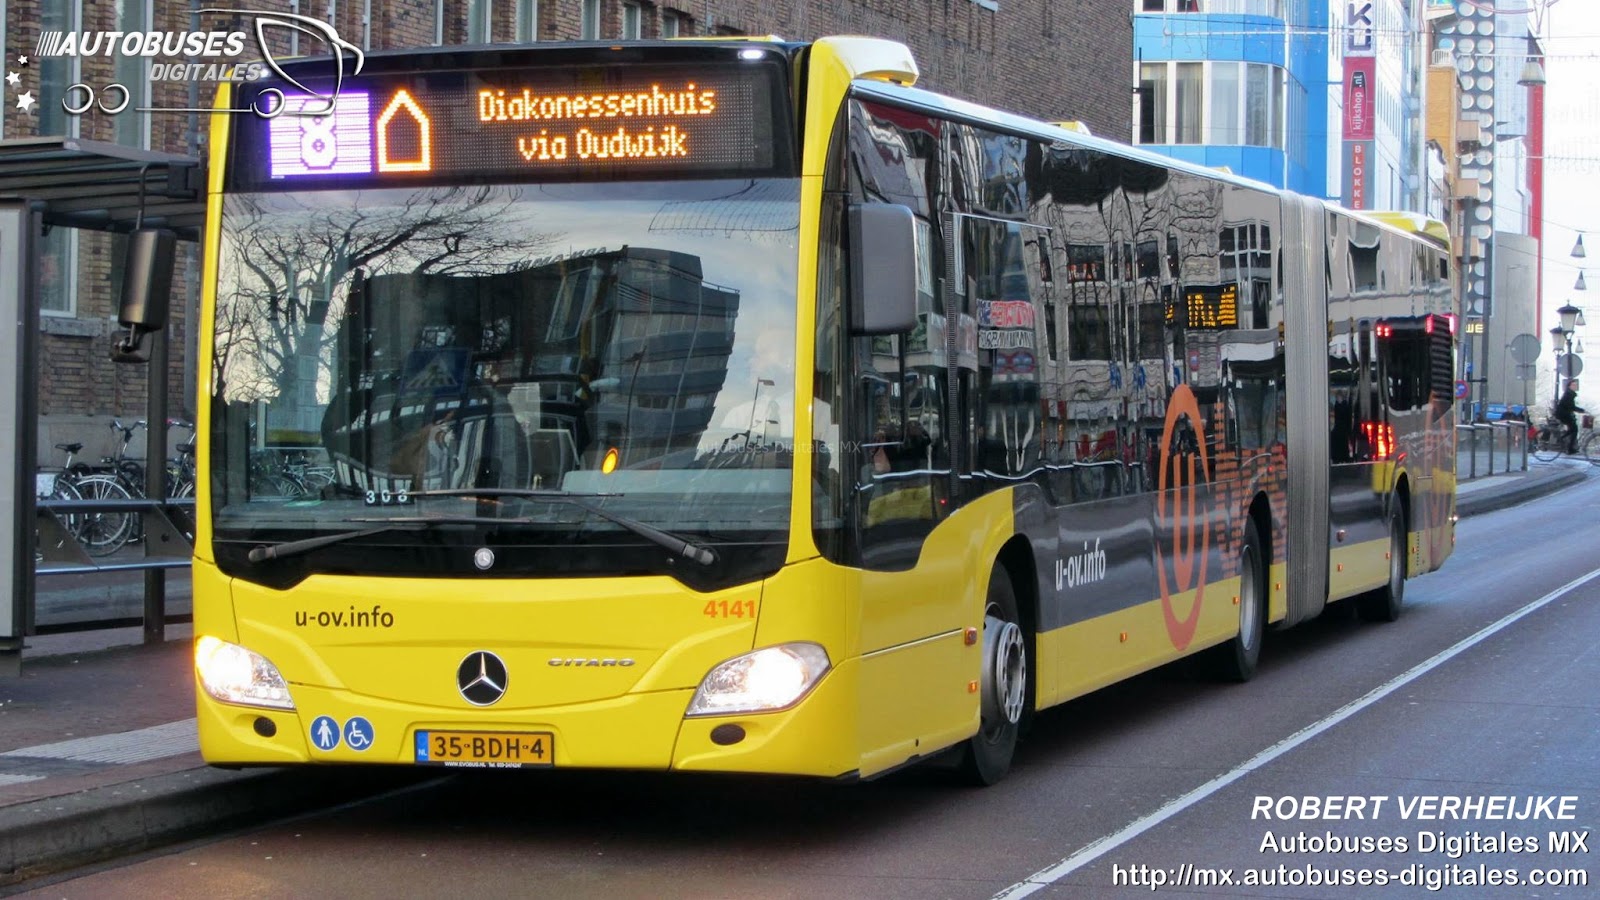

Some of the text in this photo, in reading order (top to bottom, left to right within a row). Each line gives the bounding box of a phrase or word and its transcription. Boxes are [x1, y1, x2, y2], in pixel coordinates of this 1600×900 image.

[479, 84, 716, 121] Diakonessenhuis
[518, 125, 687, 160] via Oudwijk
[1055, 537, 1106, 591] u-ov.info
[295, 605, 394, 628] u-ov.info
[703, 600, 755, 618] 4141
[547, 658, 636, 668] CITARO
[434, 736, 544, 759] 35-BDH-4
